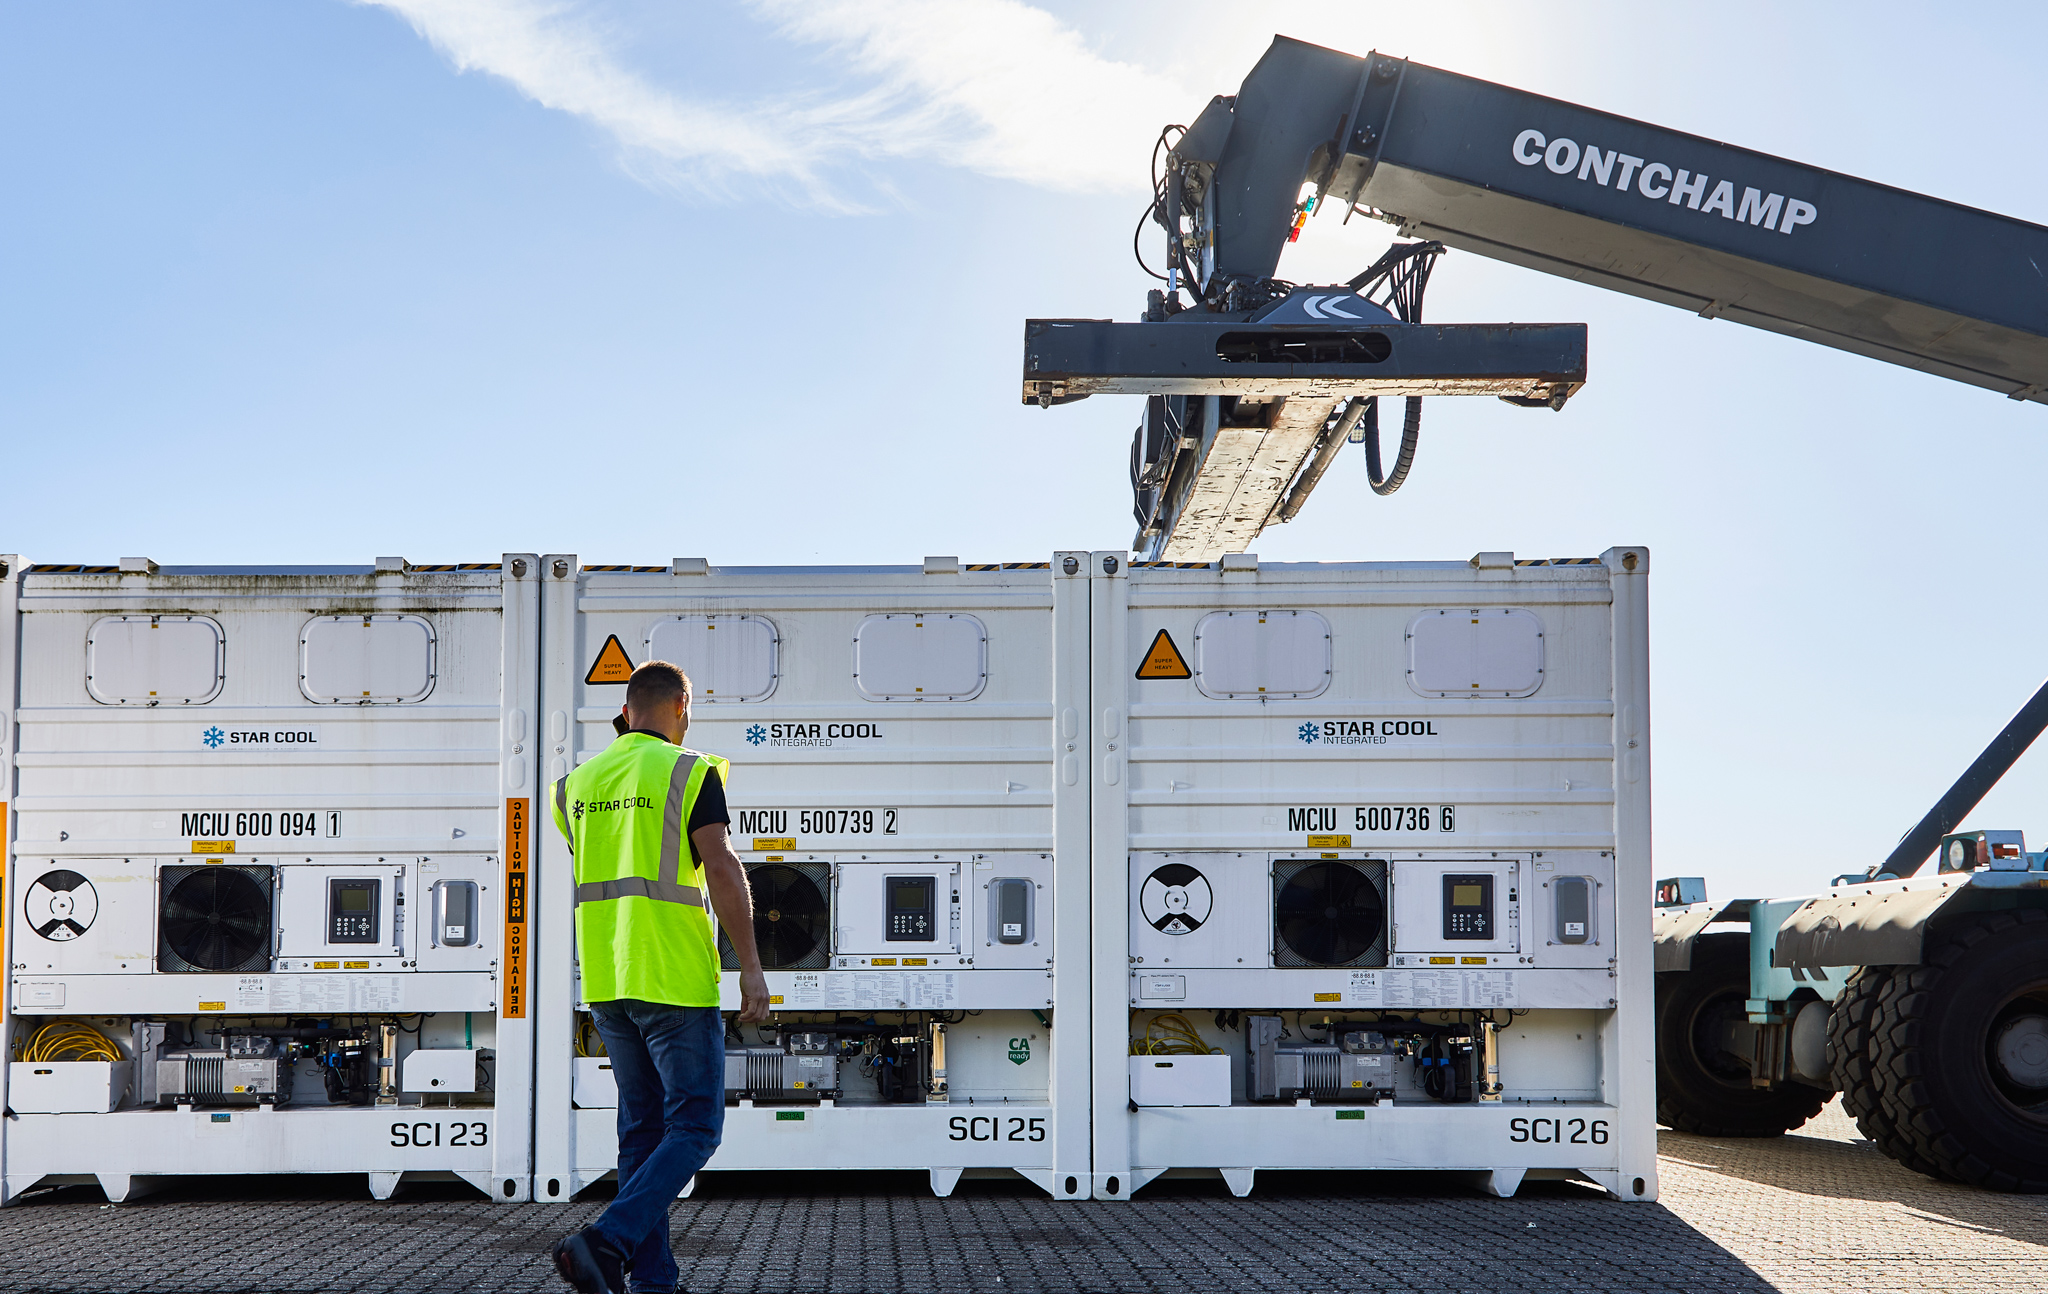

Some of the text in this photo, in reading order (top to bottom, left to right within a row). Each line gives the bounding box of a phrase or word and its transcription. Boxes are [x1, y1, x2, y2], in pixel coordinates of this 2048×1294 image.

[1512, 129, 1818, 235] CONTCHAMP
[770, 723, 883, 739] STAR COOL
[1323, 720, 1438, 736] STAR COOL
[230, 731, 318, 743] STAR COOL
[770, 738, 833, 747] INTEGRATED
[1323, 736, 1387, 744] INTEGRATED
[588, 797, 654, 813] STAR COOL
[181, 812, 339, 837] MCIU 600 094 1
[739, 810, 897, 834] MCIU 500739 2
[1288, 807, 1454, 831] MCIU 500736 6
[1008, 1037, 1030, 1051] CA
[1009, 1052, 1029, 1060] ready
[390, 1122, 488, 1147] SCI 23
[948, 1116, 1046, 1142] SCI 25
[1509, 1117, 1609, 1145] SCI 26
